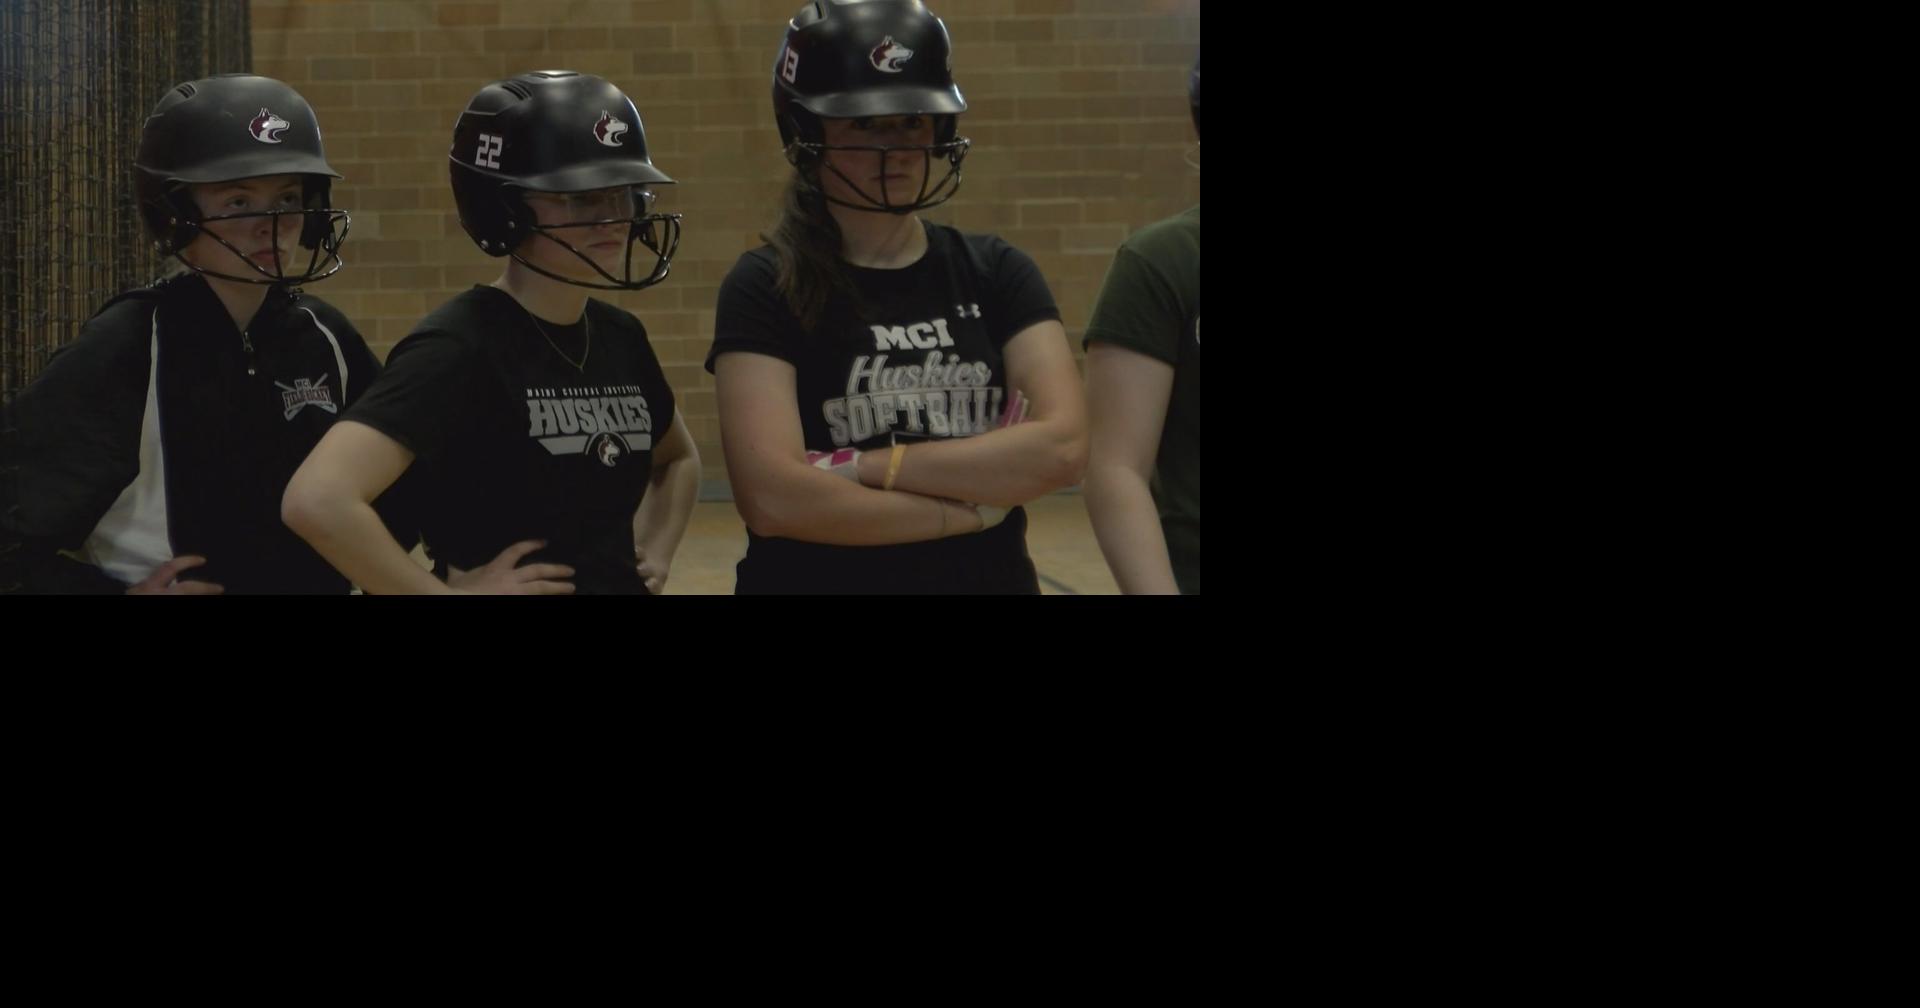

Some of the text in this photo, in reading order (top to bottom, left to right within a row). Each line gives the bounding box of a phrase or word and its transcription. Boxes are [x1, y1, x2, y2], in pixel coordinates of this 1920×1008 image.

[782, 46, 799, 84] 13
[475, 133, 503, 169] 22
[870, 318, 954, 350] MCI
[847, 350, 992, 394] Huskies
[526, 395, 652, 437] HUSKIES
